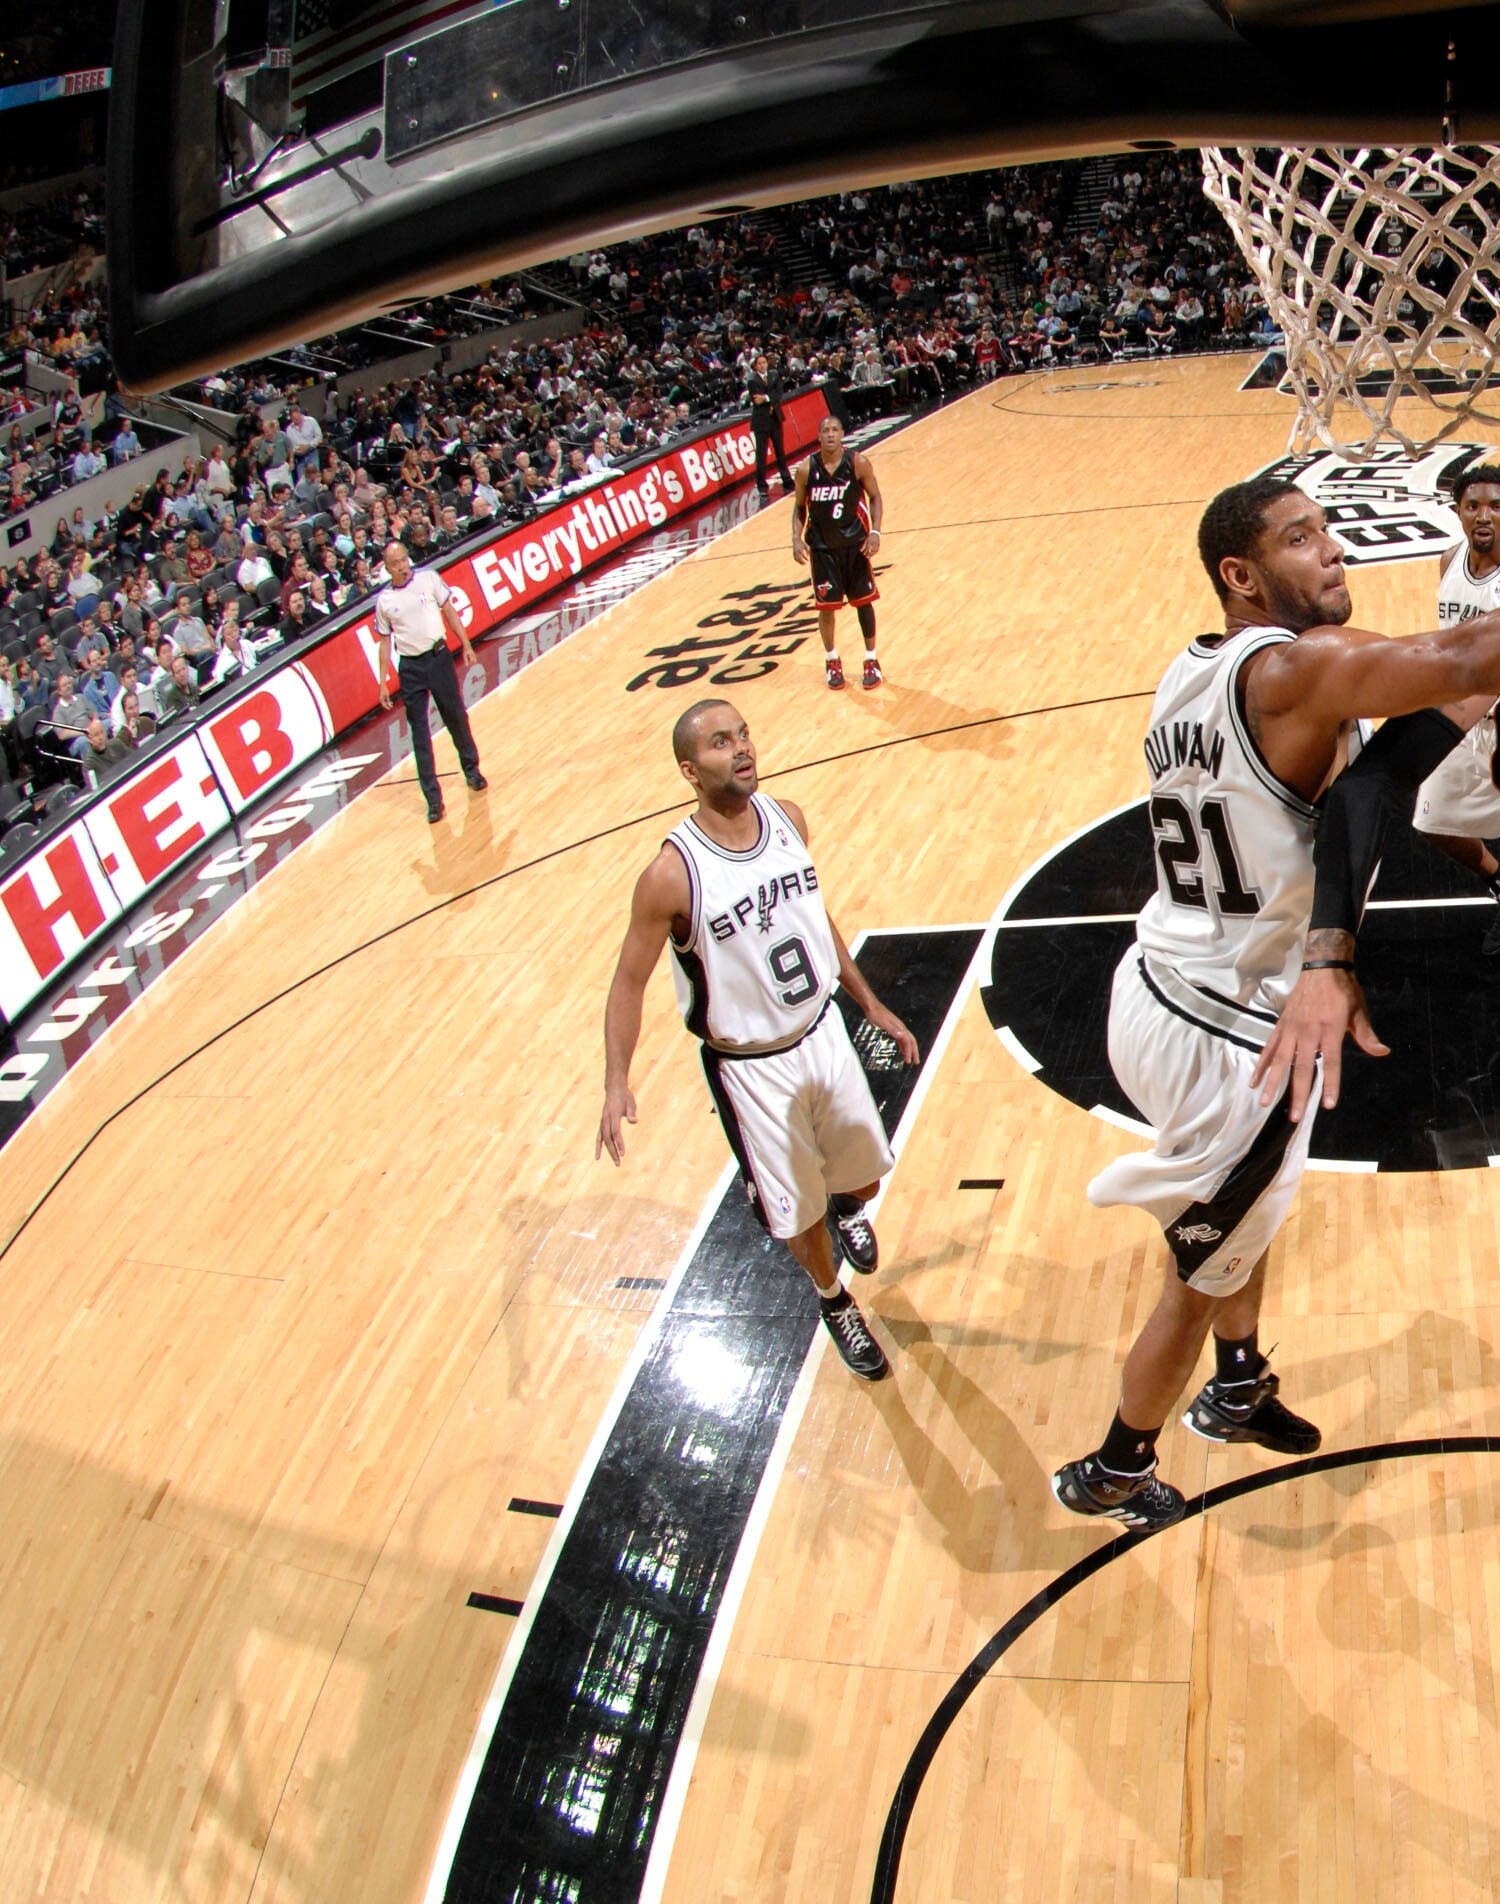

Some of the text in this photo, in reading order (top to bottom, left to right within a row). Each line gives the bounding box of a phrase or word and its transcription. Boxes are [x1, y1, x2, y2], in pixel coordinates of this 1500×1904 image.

[811, 481, 851, 503] HEAT
[831, 502, 844, 520] 6
[473, 465, 684, 611] Everything's
[1438, 602, 1486, 622] SPU
[1144, 721, 1225, 781] DUNAN
[1150, 795, 1263, 915] 21
[709, 866, 819, 942] SPURS
[767, 936, 821, 1007] 9
